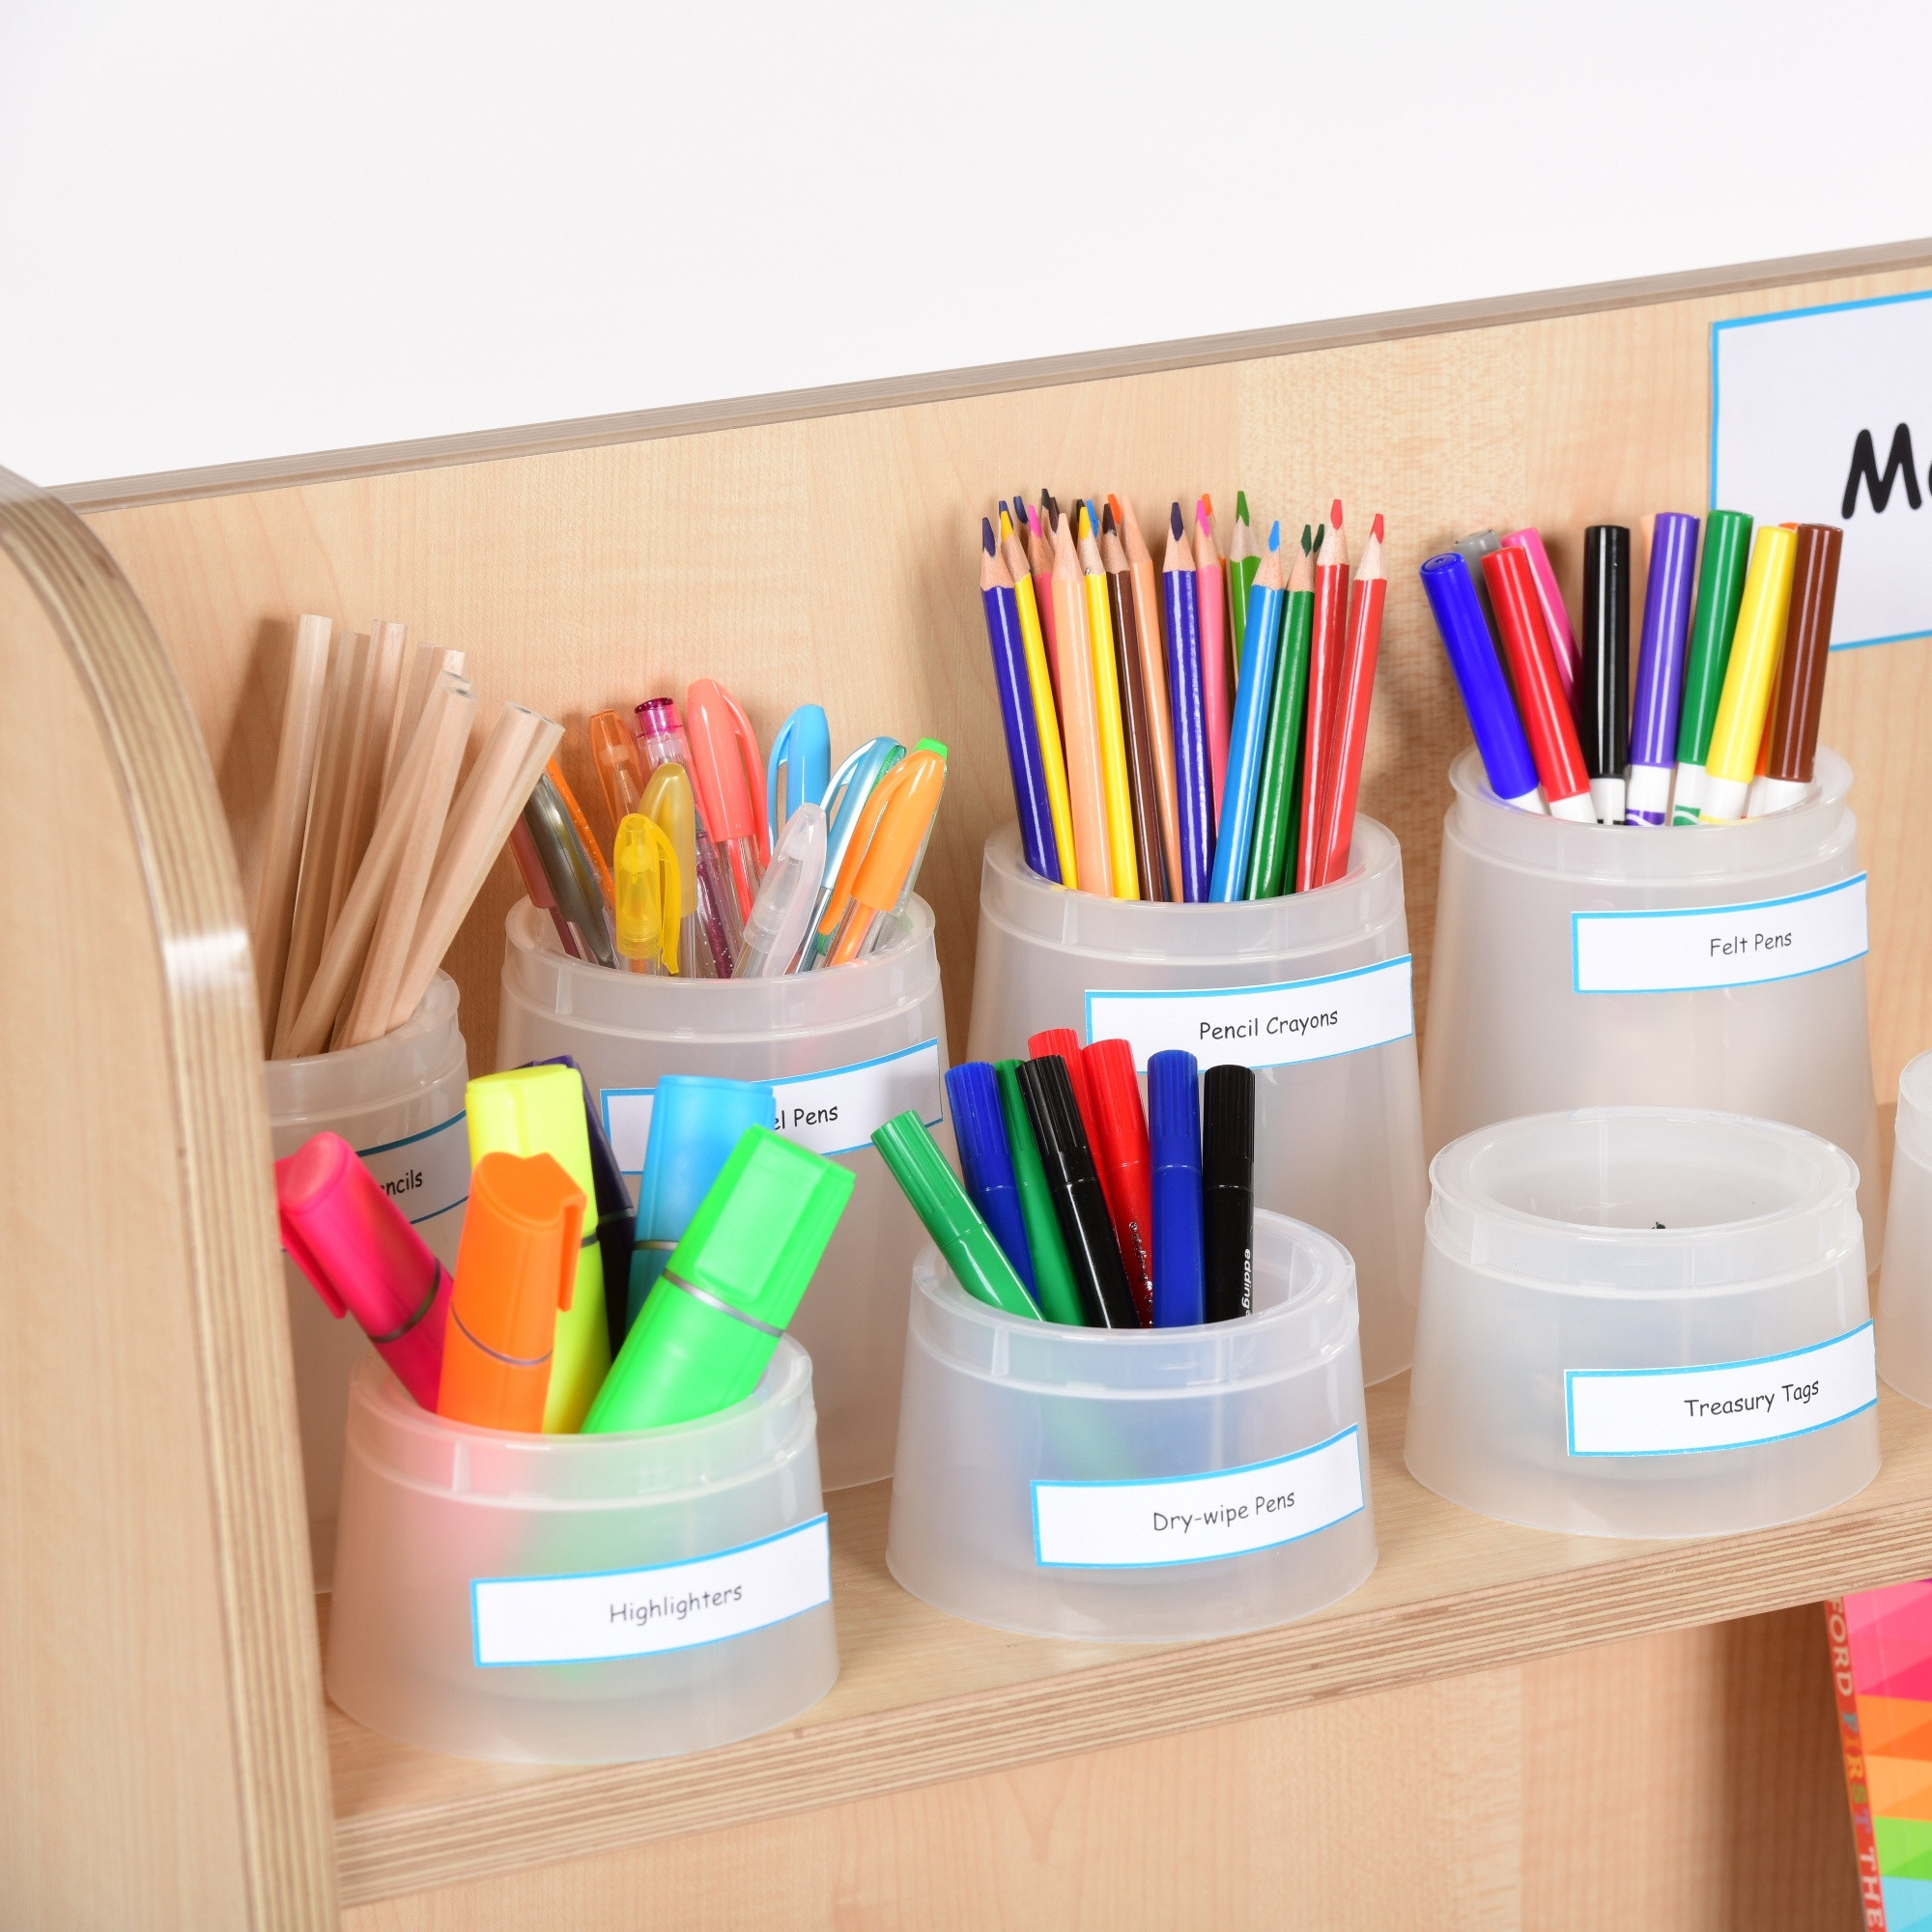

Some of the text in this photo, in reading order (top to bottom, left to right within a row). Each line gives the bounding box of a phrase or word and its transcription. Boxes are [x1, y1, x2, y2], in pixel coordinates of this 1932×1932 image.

[1841, 422, 1932, 519] M
[1710, 932, 1792, 957] Felt Pens
[1200, 1009, 1338, 1040] Pencil Crayons
[774, 1105, 838, 1131] el Pens
[380, 1169, 423, 1196] ncils
[1684, 1378, 1819, 1418] Treasury Tags
[1152, 1491, 1295, 1536] Dry-wipe Pens
[610, 1584, 743, 1627] Highlighters
[1840, 1711, 1872, 1833] FIRST
